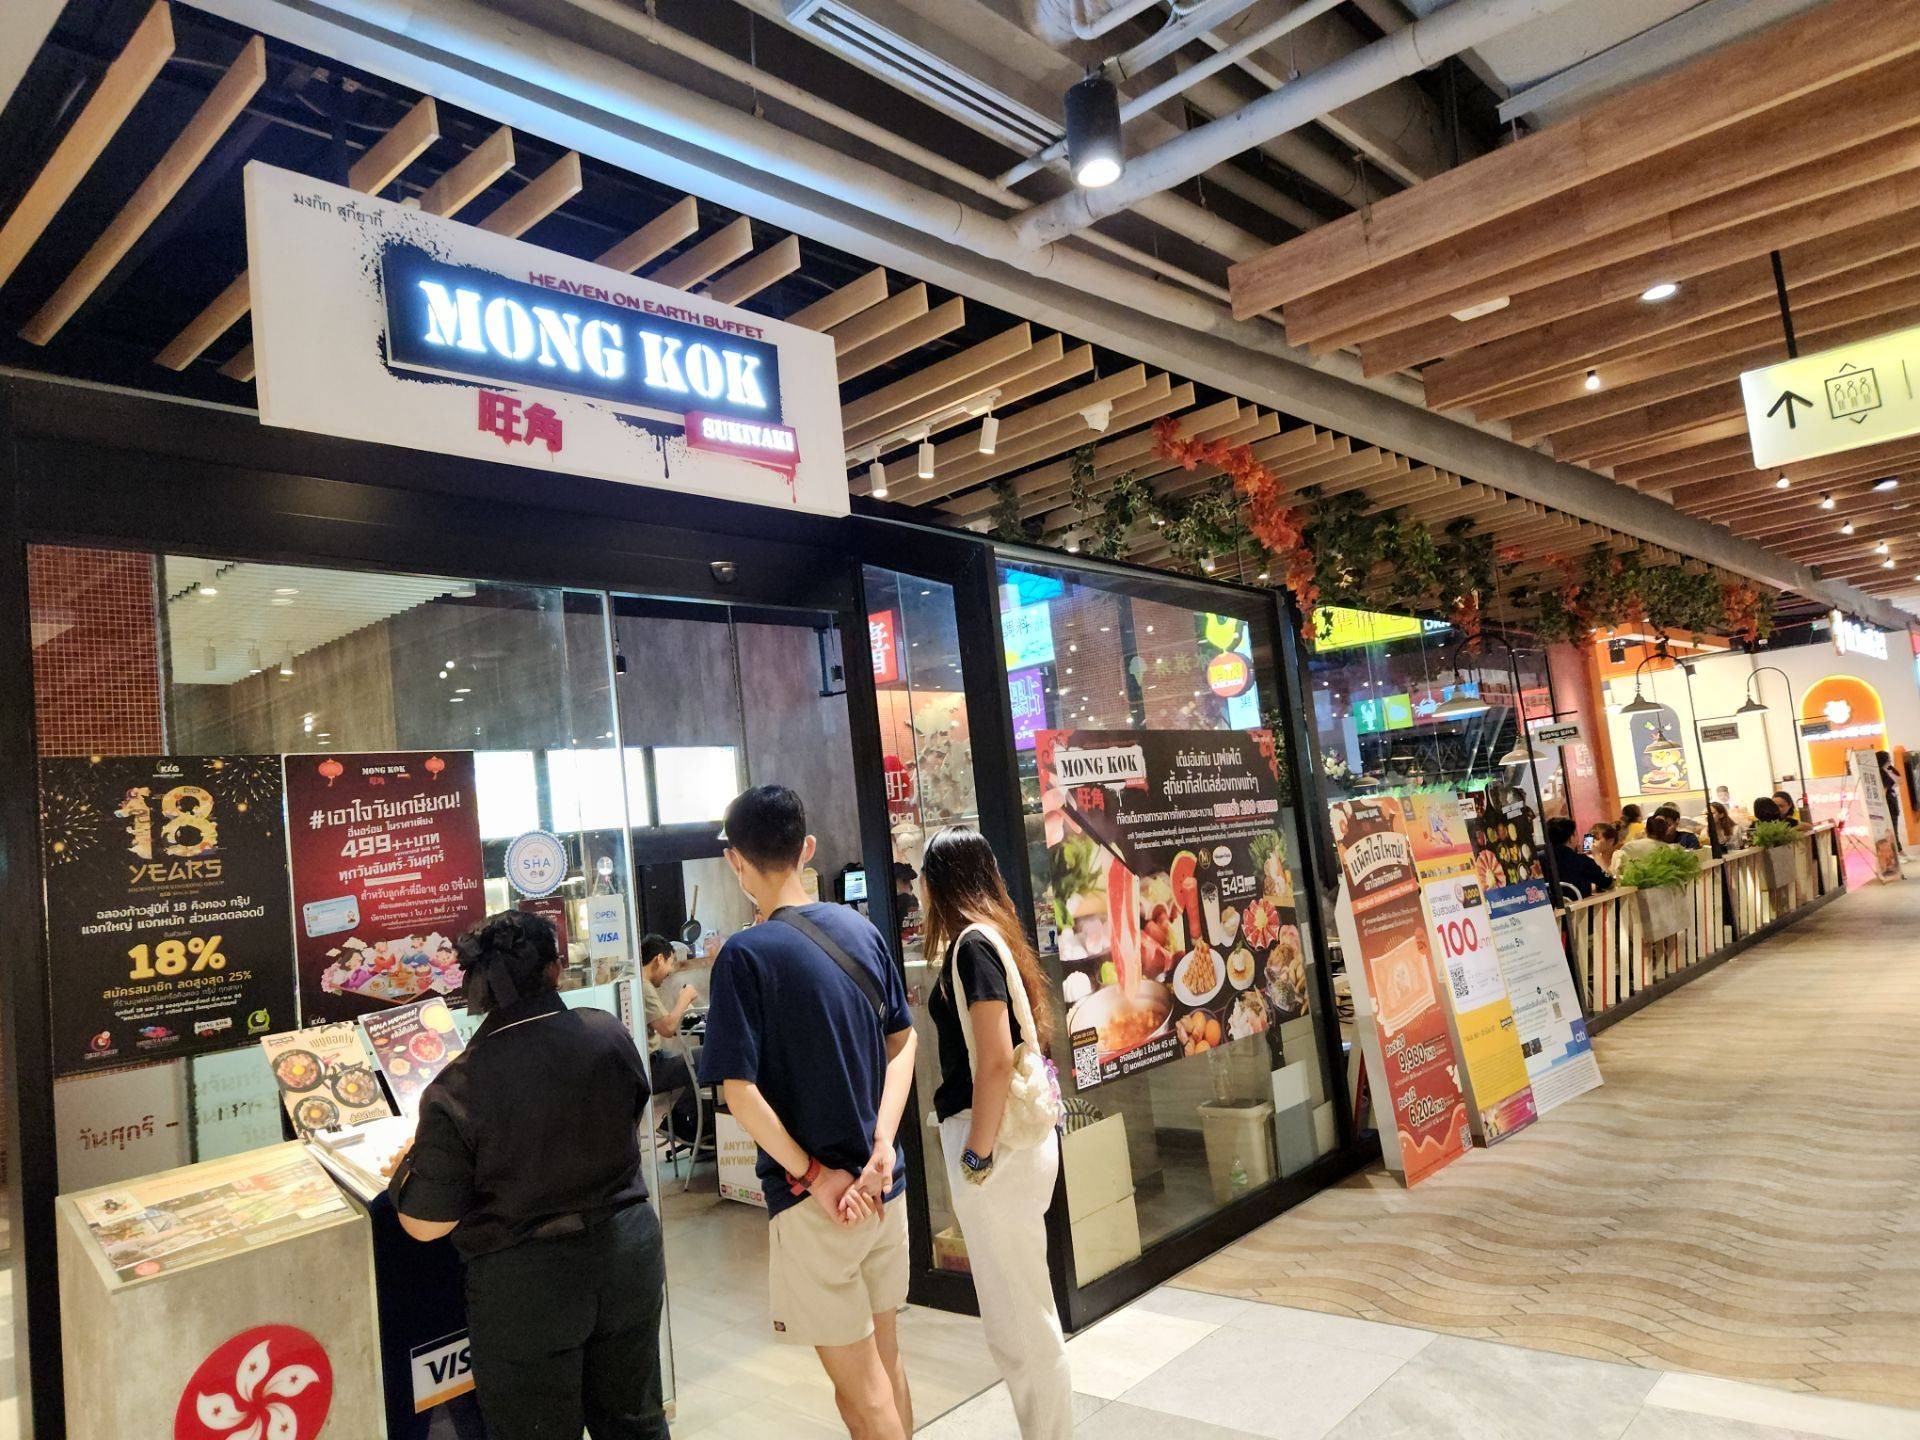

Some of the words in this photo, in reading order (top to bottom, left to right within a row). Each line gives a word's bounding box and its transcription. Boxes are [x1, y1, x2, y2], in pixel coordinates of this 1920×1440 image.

[529, 270, 610, 301] HEAVEN
[613, 292, 640, 311] ON
[643, 300, 701, 325] EARTH
[703, 315, 764, 341] BUFFET
[419, 279, 626, 380] MONG
[638, 329, 767, 409] KOK
[477, 388, 564, 453] 旺角
[701, 417, 795, 453] SUKIYAKI
[362, 767, 386, 775] MONG
[388, 765, 406, 774] KOK
[1060, 757, 1103, 778] MONG
[1107, 754, 1138, 774] KOK
[114, 785, 218, 860] 18
[128, 858, 222, 885] YEARS
[523, 858, 551, 870] SHA
[439, 883, 450, 892] 60
[1221, 875, 1246, 896] 549
[173, 902, 187, 912] 18
[191, 900, 226, 911] คิงคอง
[230, 895, 251, 908] กรุ๊ป
[595, 910, 617, 920] OPEN
[81, 918, 133, 935] แจกใหญ่
[597, 933, 619, 943] VISA
[1436, 917, 1479, 958] 100
[127, 934, 227, 980] 18%
[228, 970, 252, 981] 25%
[423, 1347, 471, 1384] VIS
